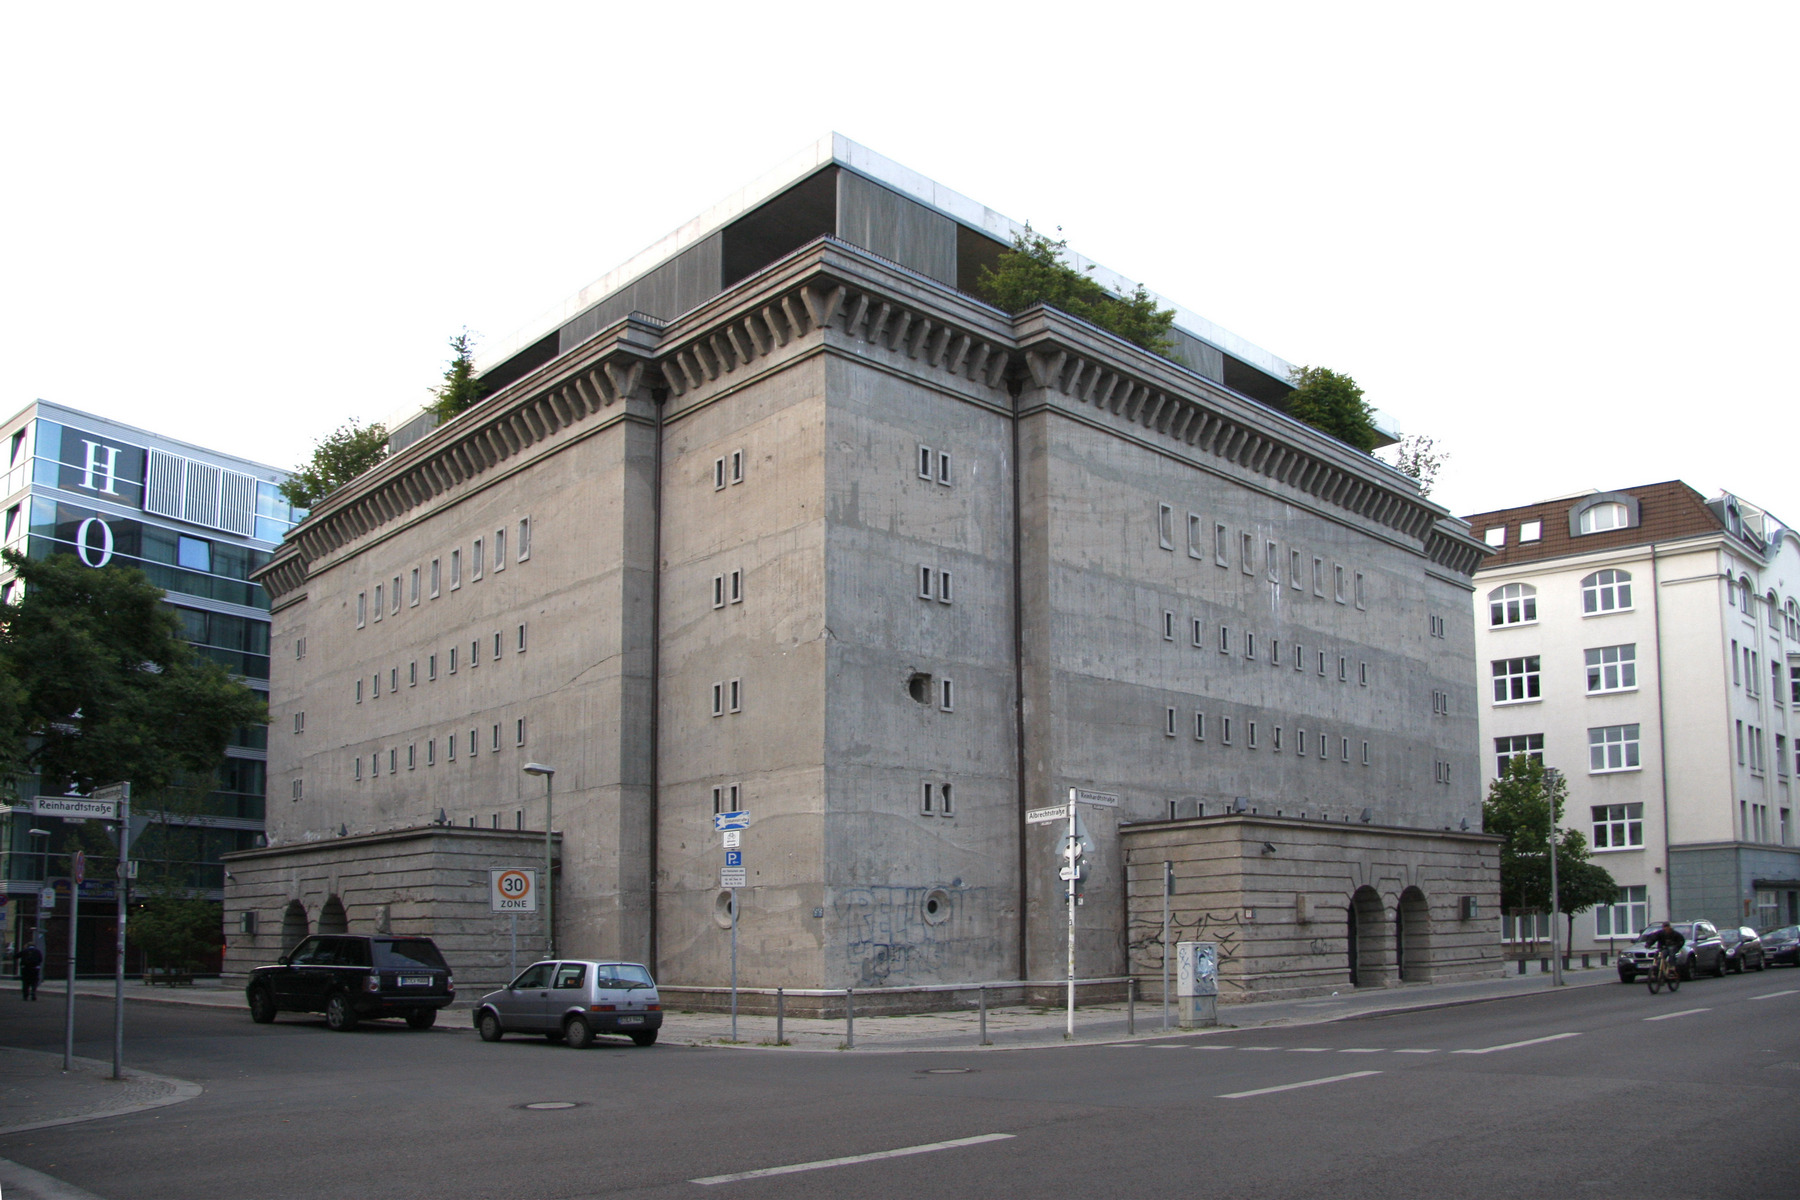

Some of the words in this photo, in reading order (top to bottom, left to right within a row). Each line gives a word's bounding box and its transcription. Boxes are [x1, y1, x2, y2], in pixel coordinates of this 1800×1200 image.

[39, 799, 112, 815] Reinhardtstraße
[1029, 808, 1065, 820] Albrechtstraße
[728, 853, 737, 865] P
[504, 878, 523, 892] 30
[500, 899, 527, 908] ZONE
